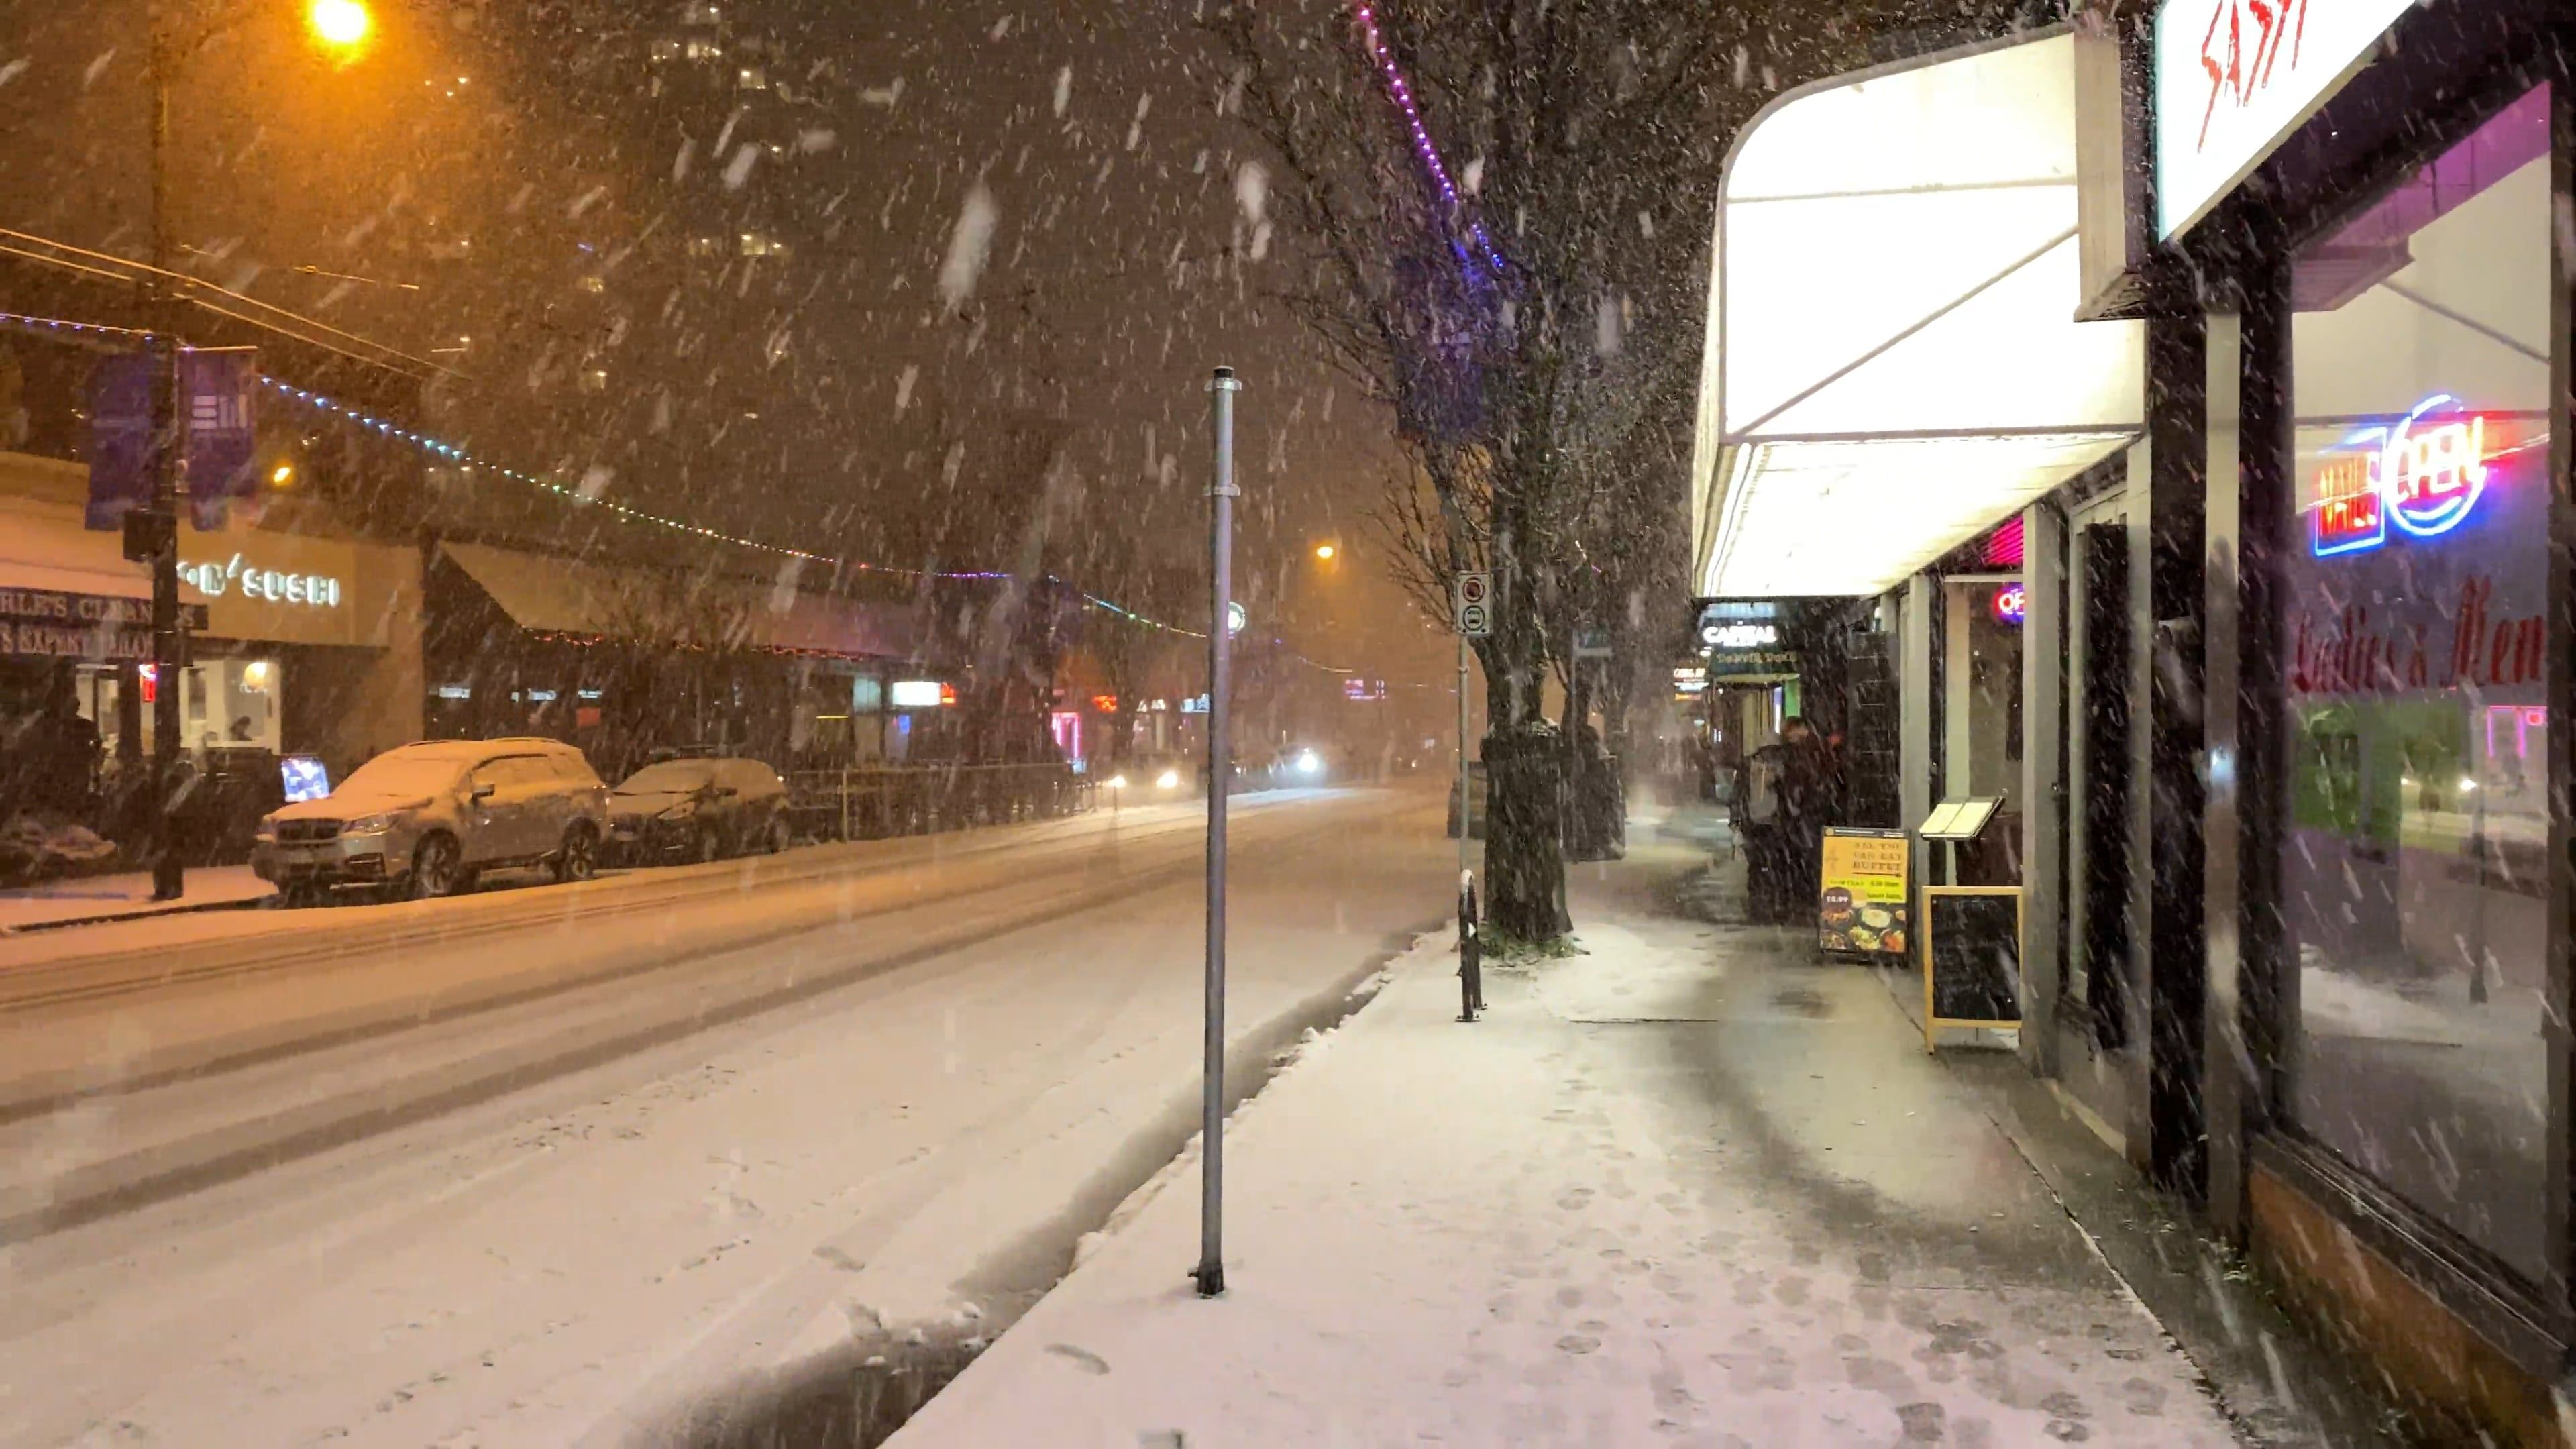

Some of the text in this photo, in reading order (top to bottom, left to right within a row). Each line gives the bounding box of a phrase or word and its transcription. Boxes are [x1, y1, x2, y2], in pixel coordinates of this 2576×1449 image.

[2385, 415, 2483, 504] OPEN
[242, 568, 340, 607] SUSHI
[2440, 576, 2544, 688] Men
